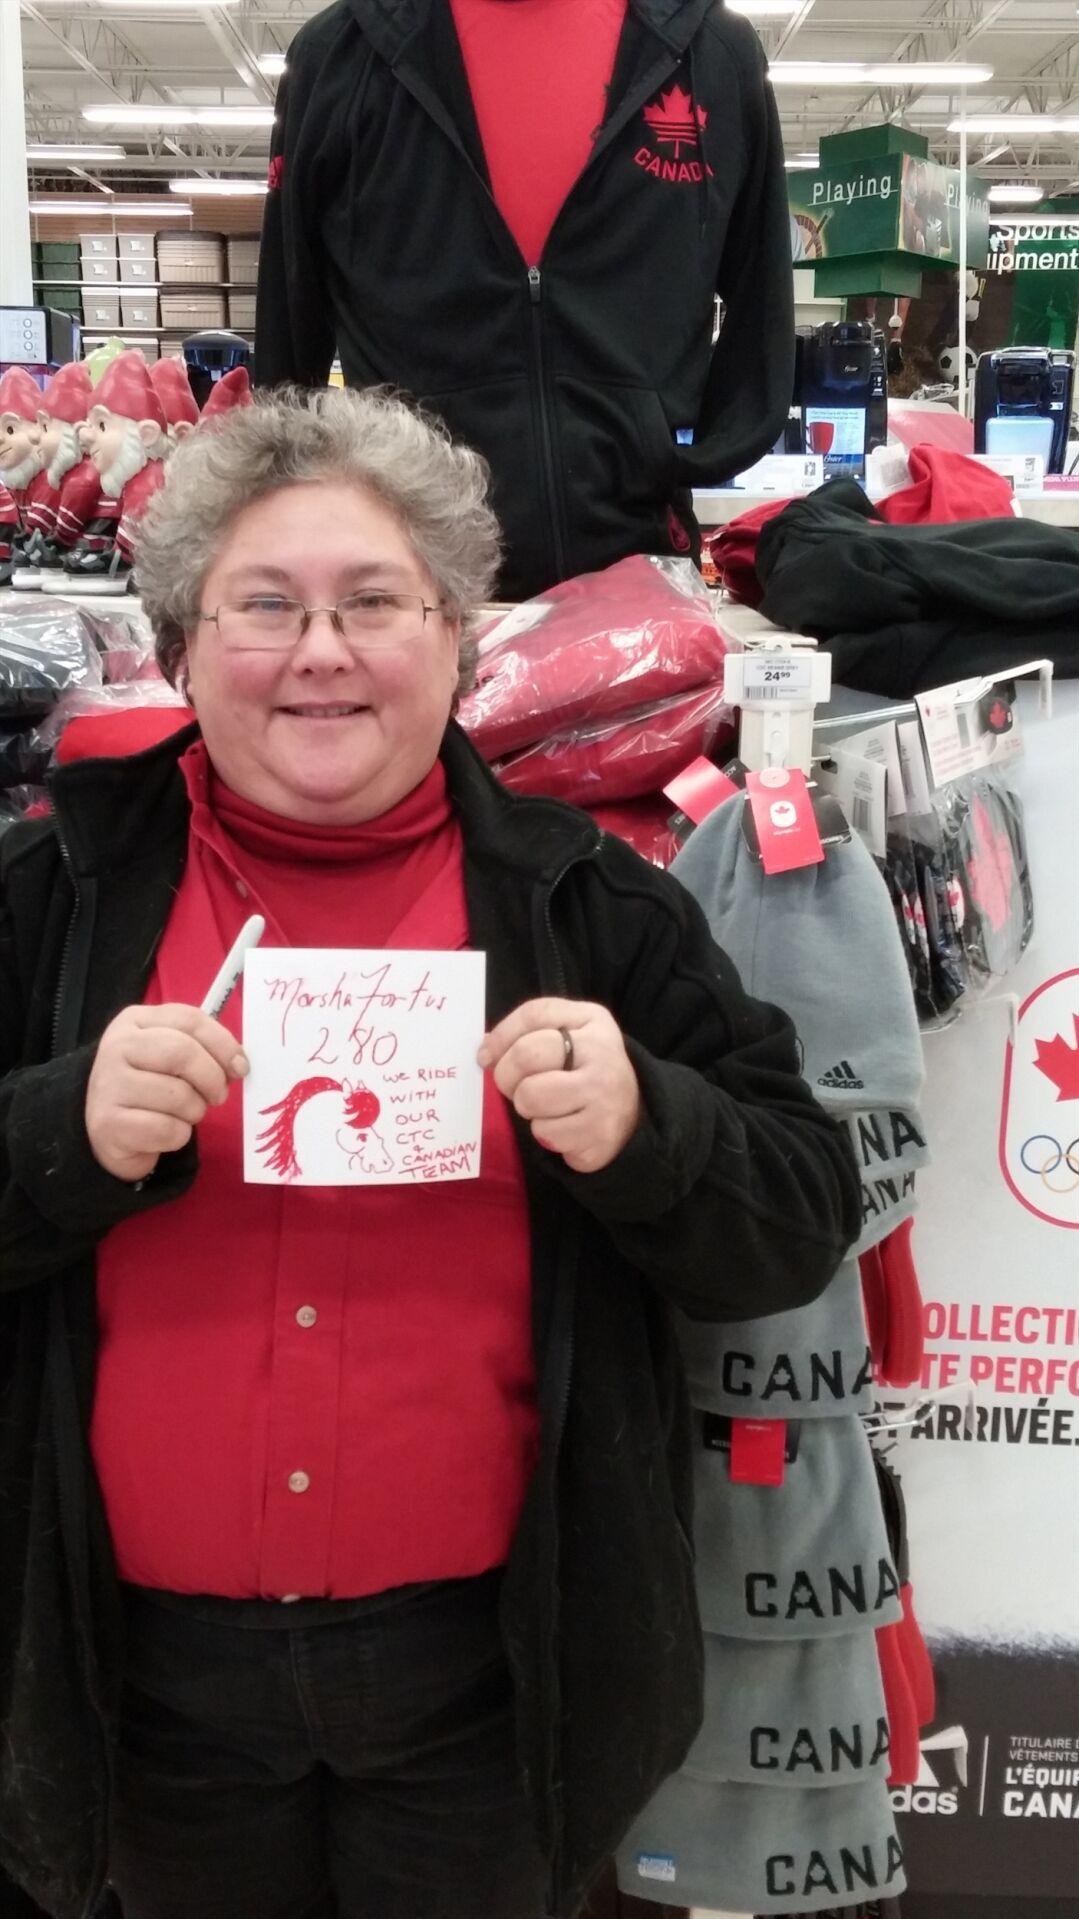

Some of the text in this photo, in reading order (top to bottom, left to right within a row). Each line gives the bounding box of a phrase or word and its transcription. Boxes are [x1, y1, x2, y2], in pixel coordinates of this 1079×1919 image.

[812, 173, 892, 203] Playing
[946, 183, 989, 219] Plying
[308, 1026, 398, 1065] 280
[418, 1066, 457, 1082] RIDE
[818, 1078, 864, 1090] adidas
[395, 1108, 440, 1126] OUR
[396, 1129, 435, 1145] CTC
[402, 1141, 477, 1166] CANADIAN
[398, 1156, 471, 1179] TEAM
[1010, 1736, 1072, 1749] TITULAIRE
